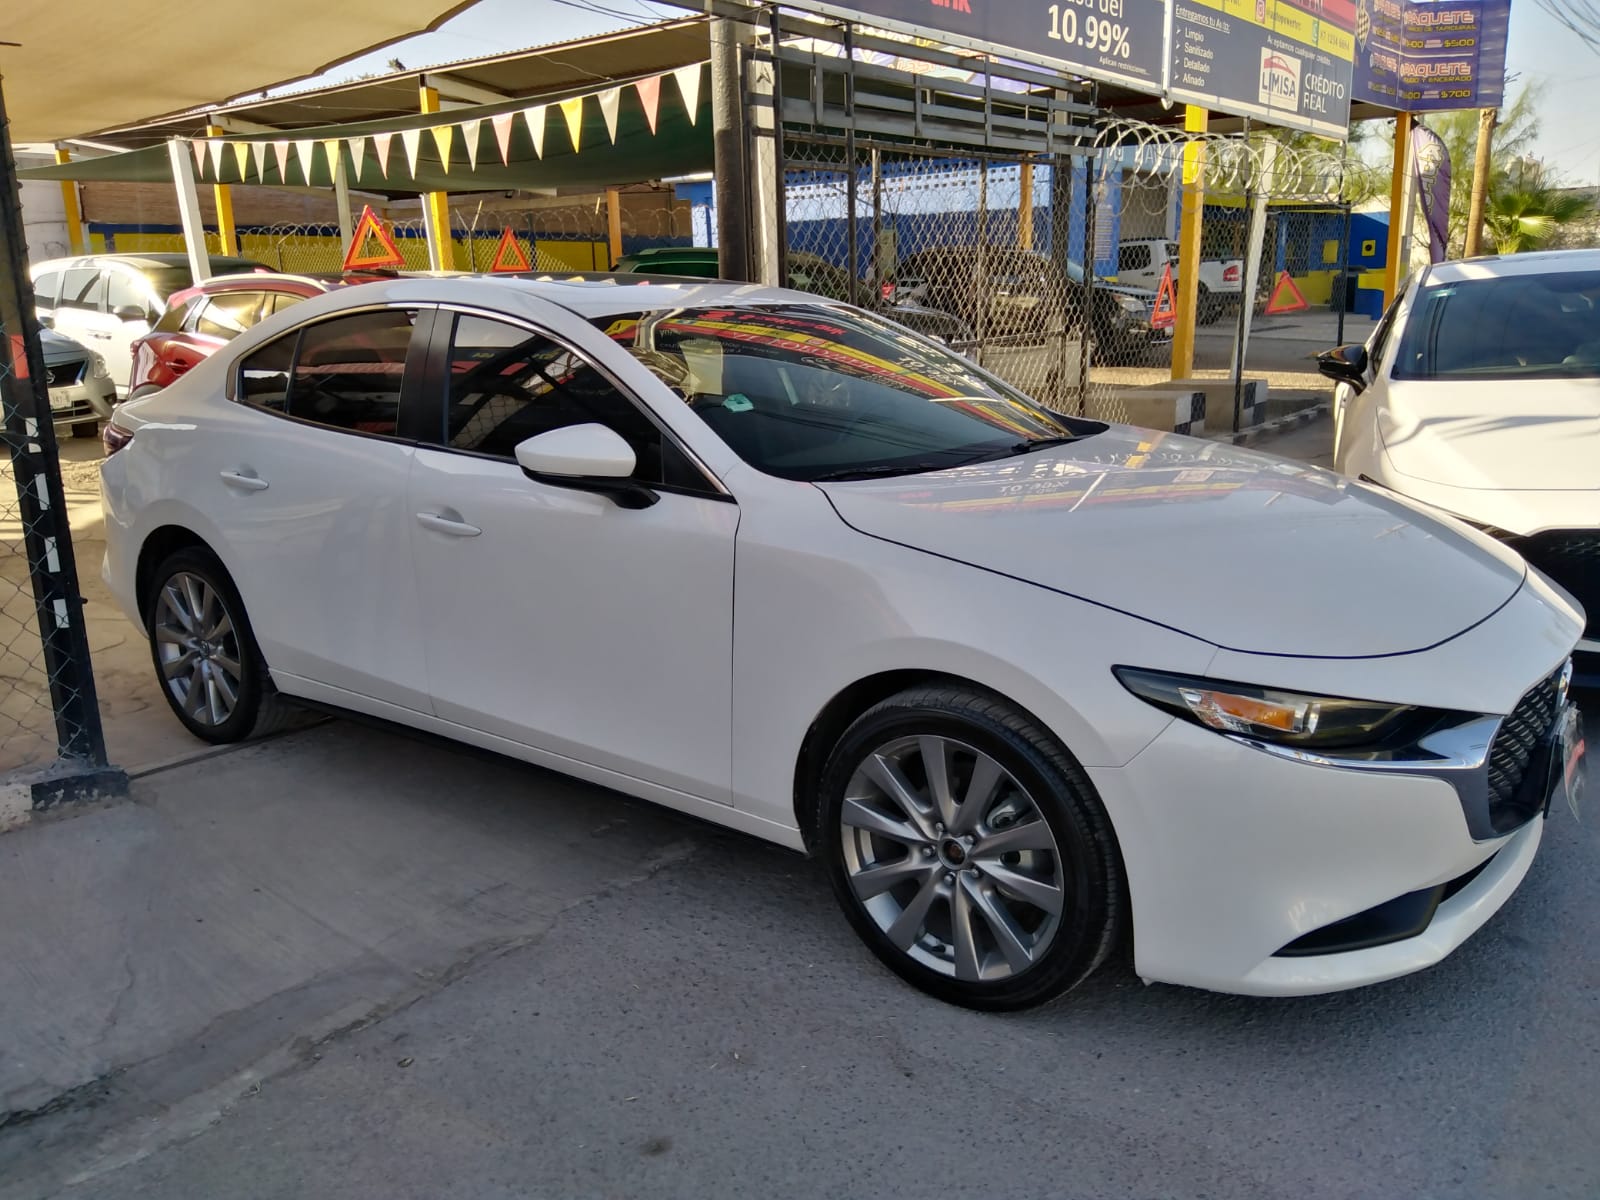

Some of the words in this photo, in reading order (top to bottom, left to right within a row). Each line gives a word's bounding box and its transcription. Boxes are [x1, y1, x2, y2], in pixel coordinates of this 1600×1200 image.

[1175, 4, 1209, 27] Entregamos
[1047, 4, 1131, 58] 10.99%
[1184, 27, 1204, 43] Limpio
[1183, 57, 1211, 74] Detallado
[1182, 72, 1206, 88] Afinado
[1261, 71, 1297, 99] LIMISA
[1304, 73, 1345, 100] CRÉDITO
[1303, 92, 1327, 114] REAL
